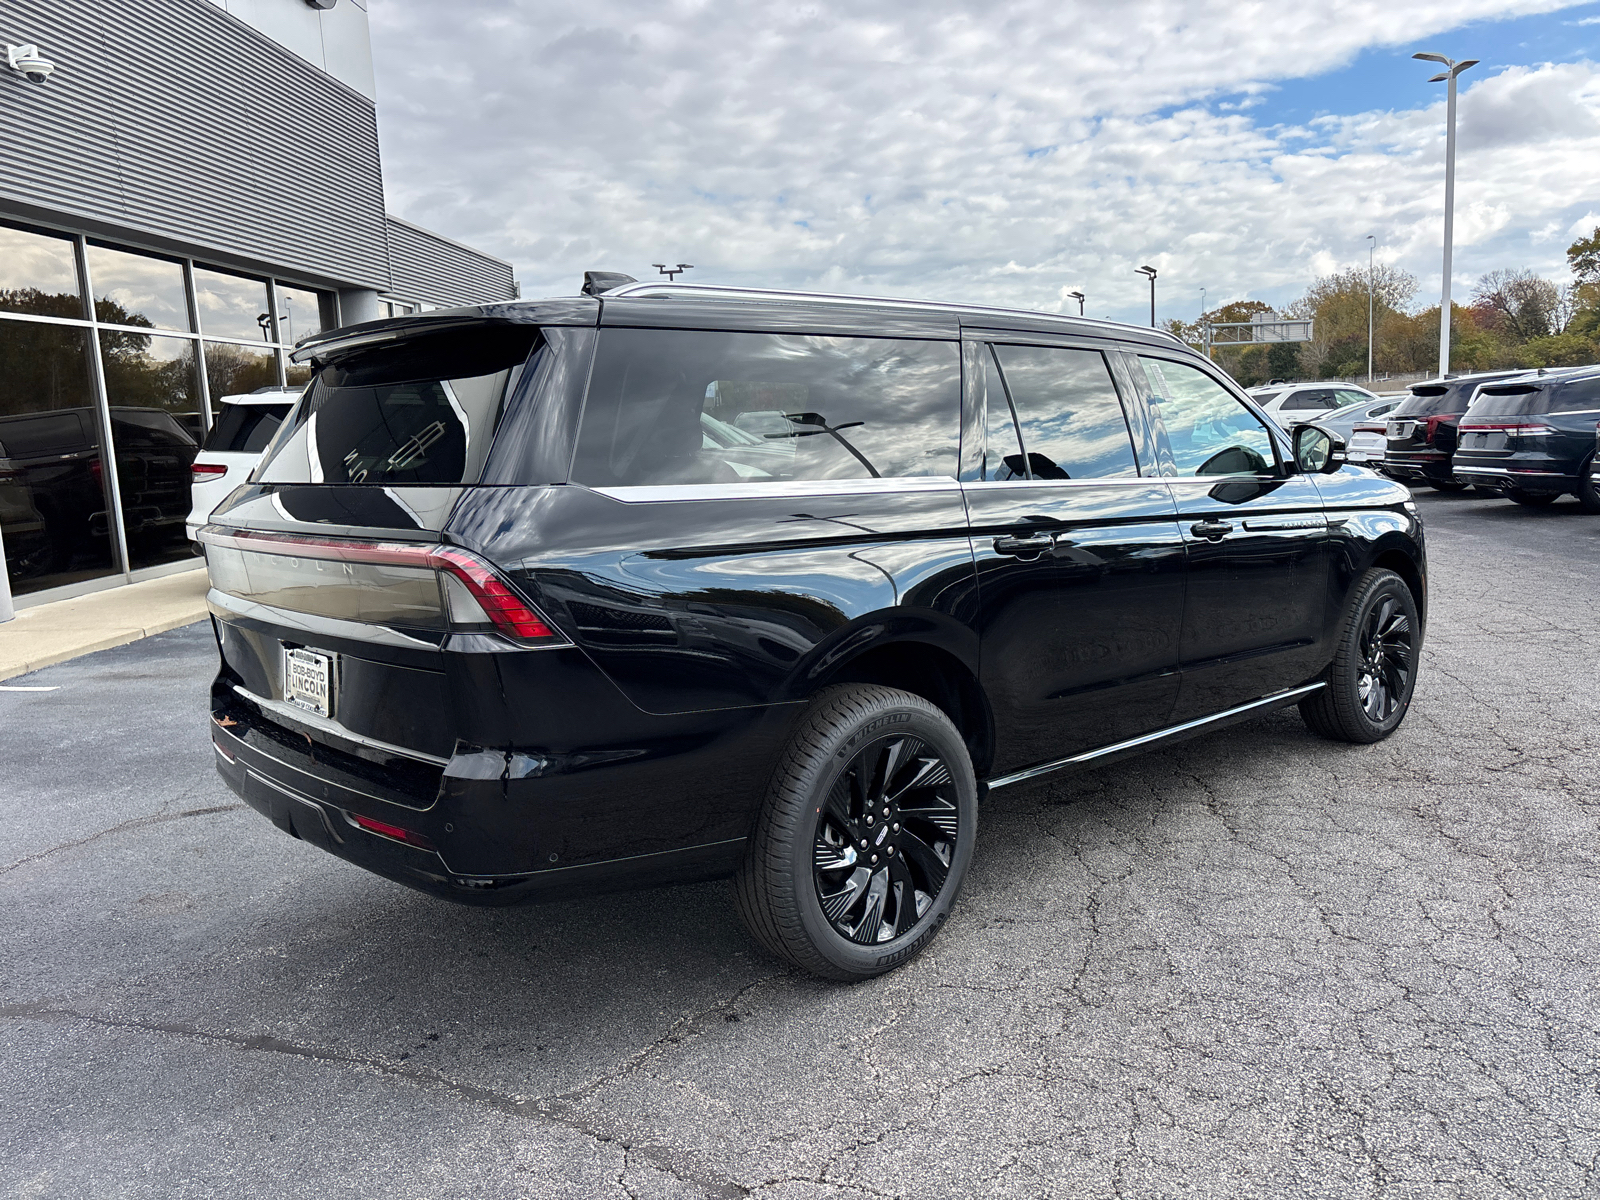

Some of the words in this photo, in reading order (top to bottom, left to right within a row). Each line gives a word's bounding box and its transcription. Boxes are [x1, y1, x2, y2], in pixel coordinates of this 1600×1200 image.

[293, 675, 326, 699] LINCOLN
[854, 713, 909, 744] MICHELIN
[880, 927, 932, 965] MICHELIN
